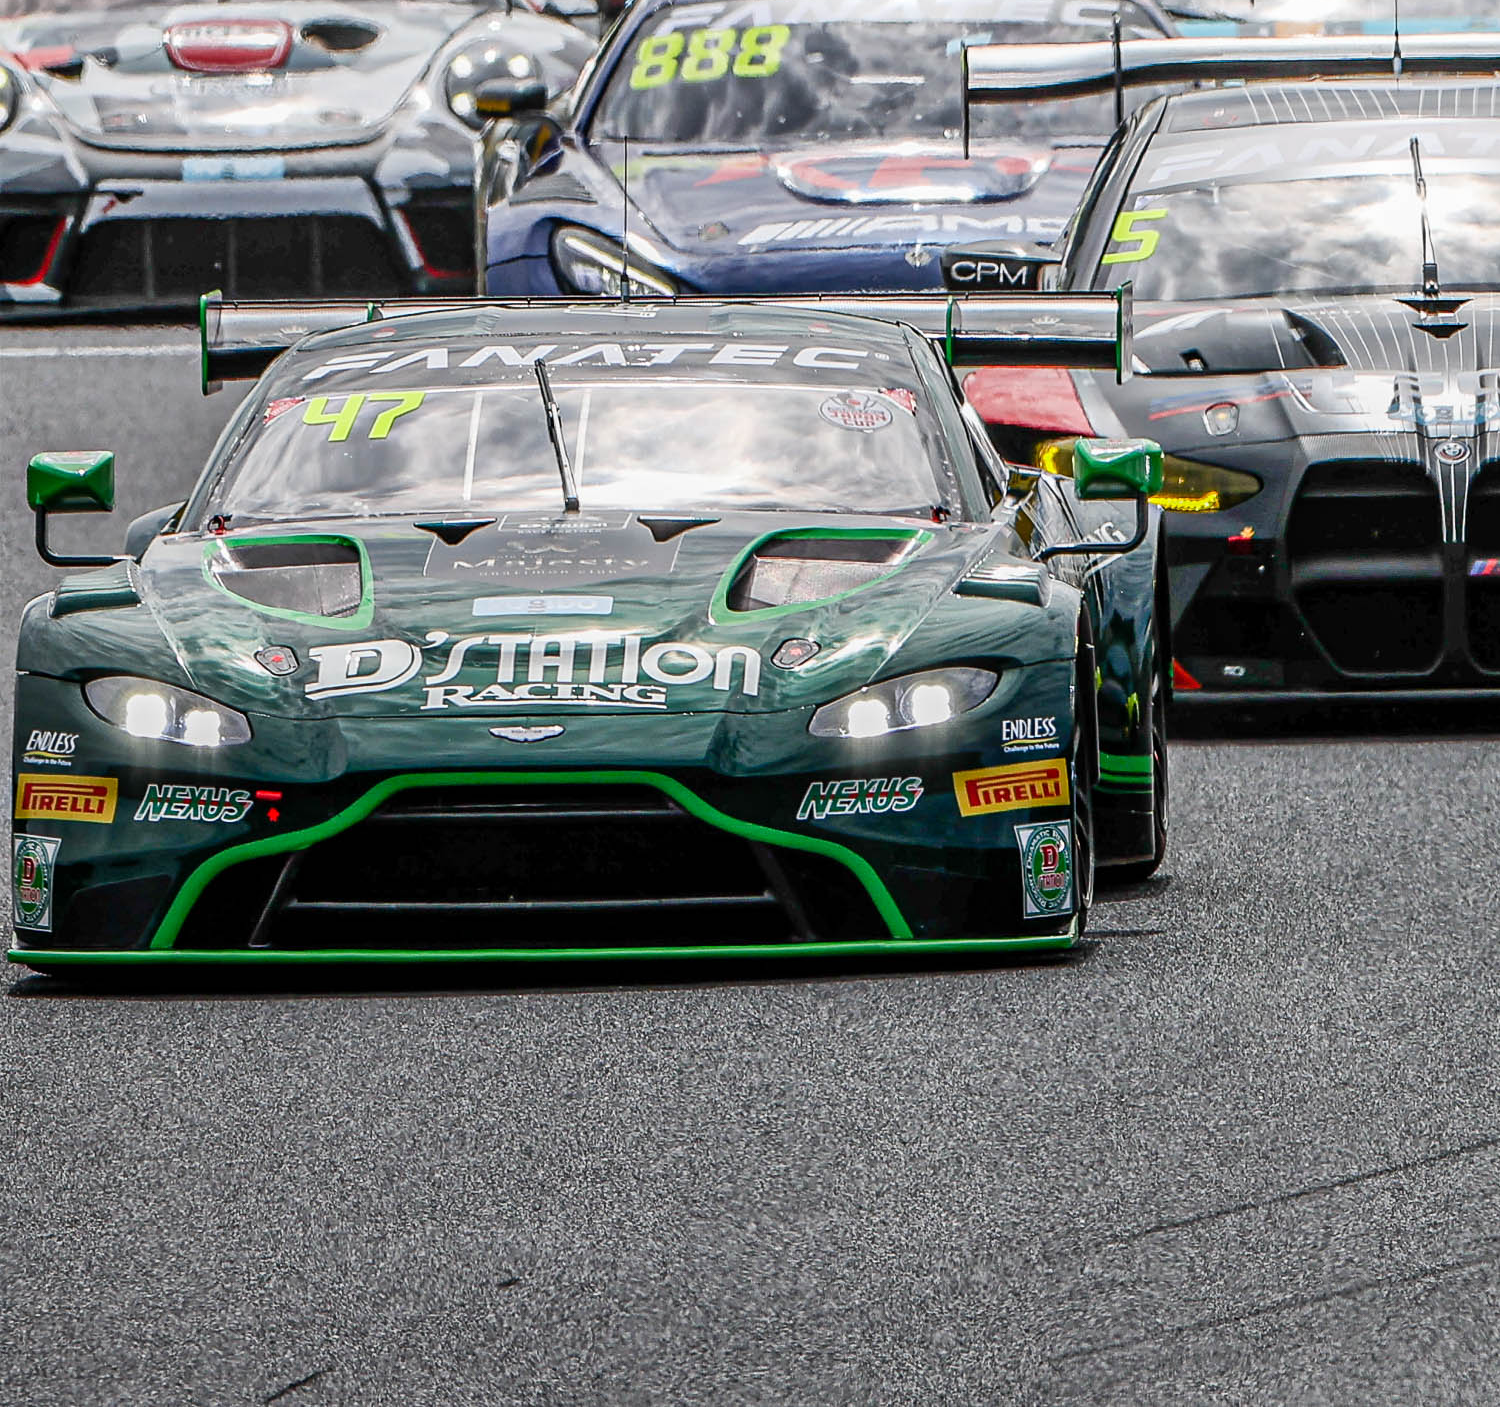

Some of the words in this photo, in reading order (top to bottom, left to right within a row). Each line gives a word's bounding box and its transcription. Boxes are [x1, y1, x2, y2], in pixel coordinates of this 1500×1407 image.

[629, 24, 790, 90] 888
[1099, 208, 1168, 265] 5
[950, 260, 1028, 286] CPM
[302, 343, 870, 382] FANATEC
[302, 391, 426, 443] 47
[420, 683, 668, 710] RACING
[25, 729, 79, 754] ENDLESS
[1001, 716, 1056, 741] ENDLESS
[22, 782, 109, 814] PIRELLI
[134, 783, 254, 823] NEXUS
[796, 777, 924, 820] NEXUS
[964, 767, 1061, 808] PIRELLI
